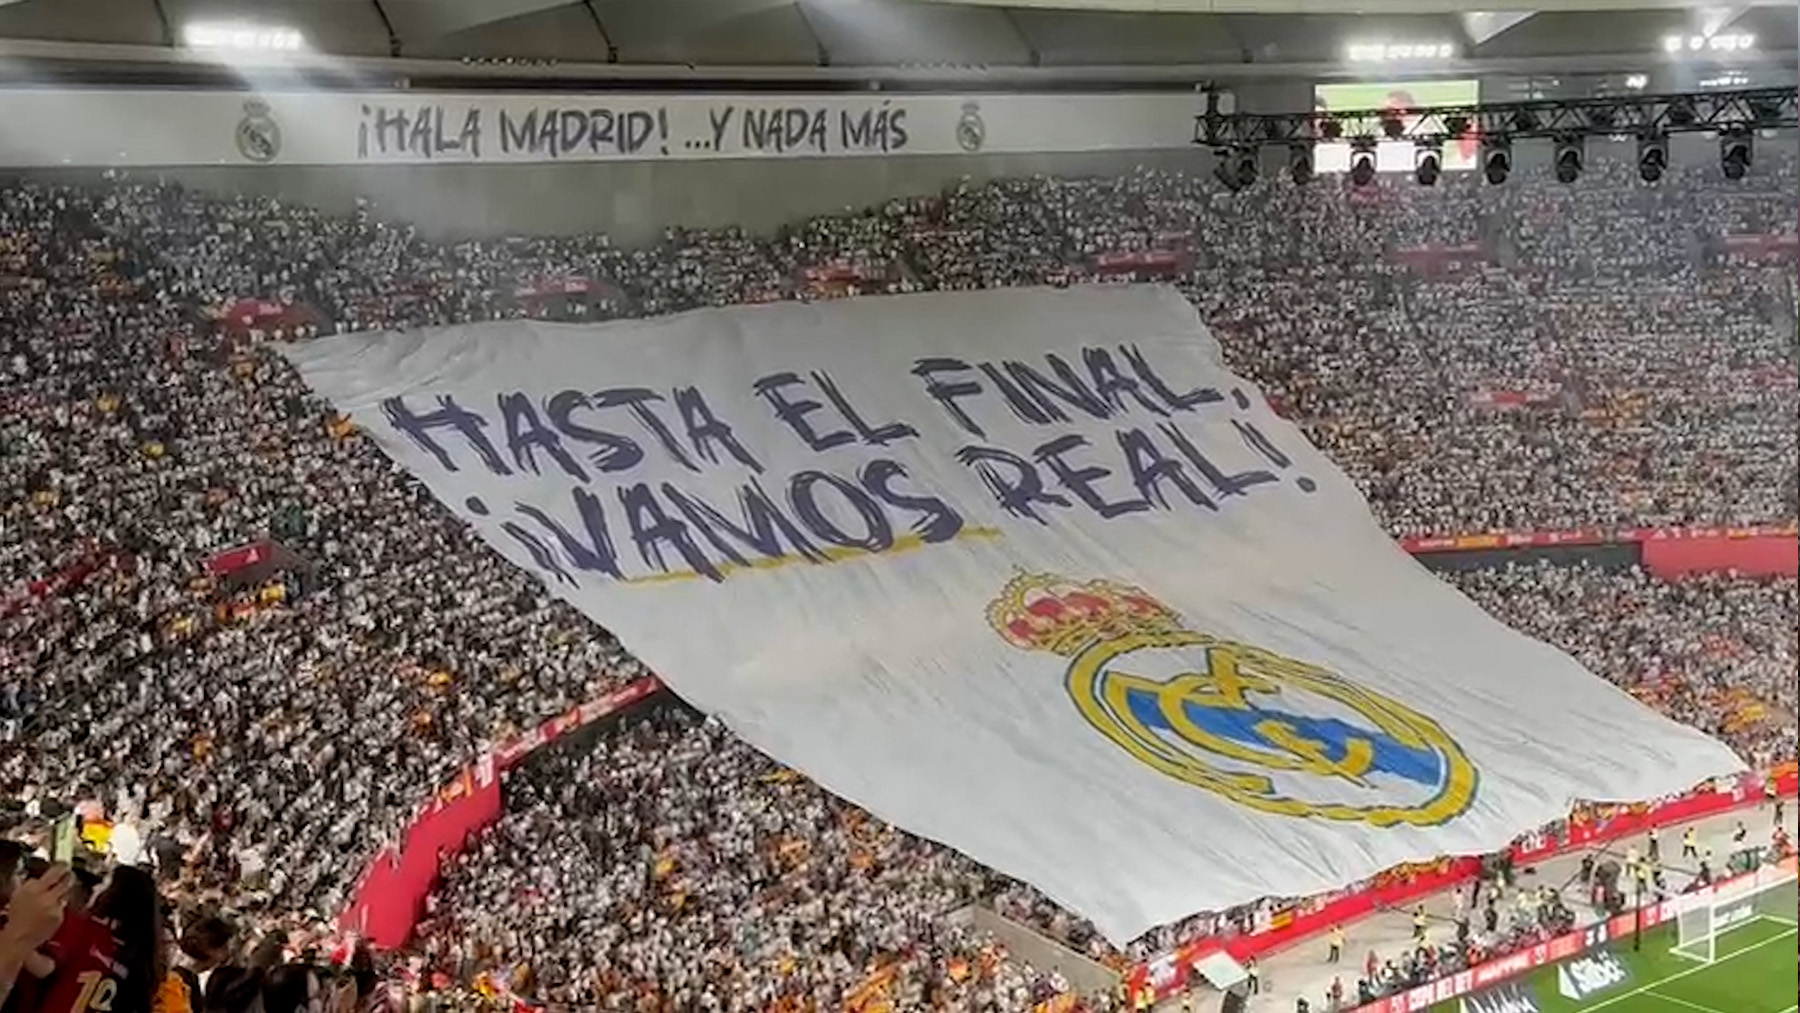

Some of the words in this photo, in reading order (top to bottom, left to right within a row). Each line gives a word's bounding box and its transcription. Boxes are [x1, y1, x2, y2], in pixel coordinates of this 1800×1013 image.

[358, 103, 481, 158] ¡HALA
[500, 107, 669, 157] MADRID!
[744, 107, 827, 153] NADA
[841, 99, 908, 153] MÁS
[379, 385, 766, 484] HASTA
[752, 369, 919, 451] EL
[910, 343, 1251, 440] FINAL,
[465, 457, 964, 588] ¡VAMOS
[954, 418, 1316, 526] REAL!
